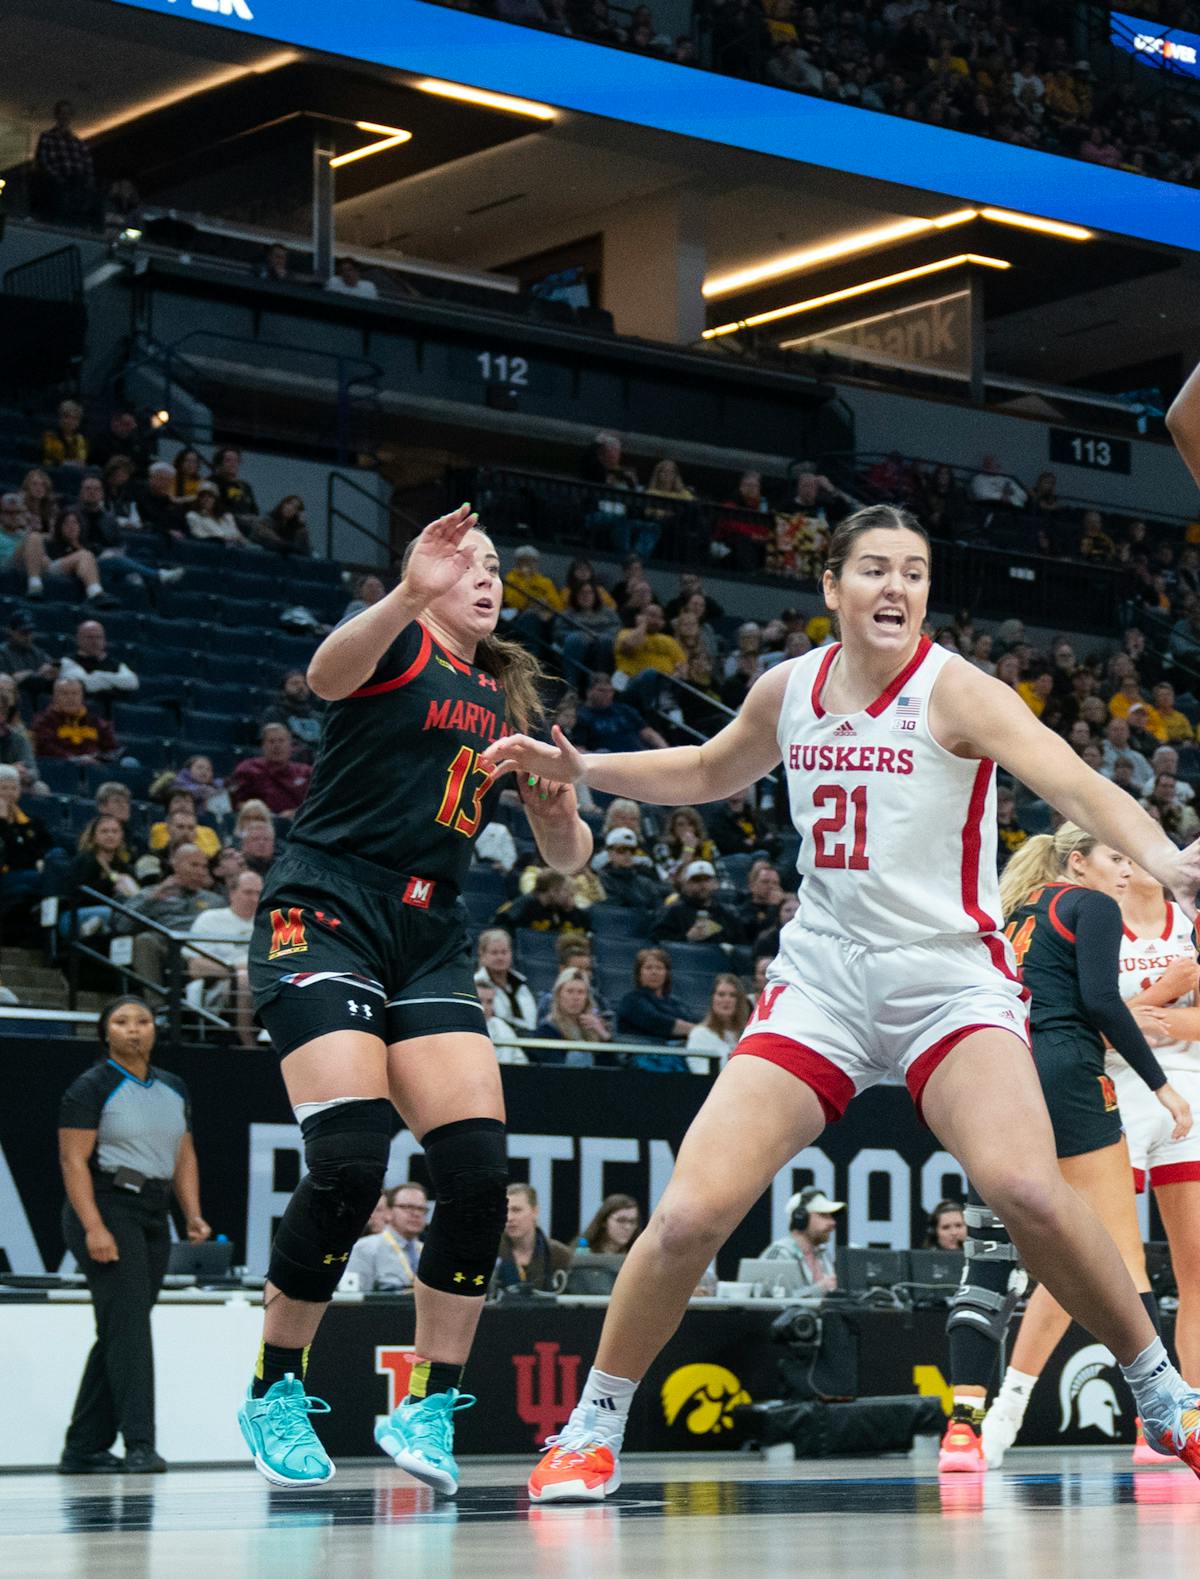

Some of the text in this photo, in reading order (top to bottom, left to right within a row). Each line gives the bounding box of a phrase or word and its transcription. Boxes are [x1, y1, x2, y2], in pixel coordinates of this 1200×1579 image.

[477, 351, 529, 386] 112
[1071, 437, 1111, 466] 113
[789, 743, 914, 776] HUSKERS
[435, 745, 499, 838] 13
[812, 784, 869, 870] 21
[269, 906, 308, 952] M
